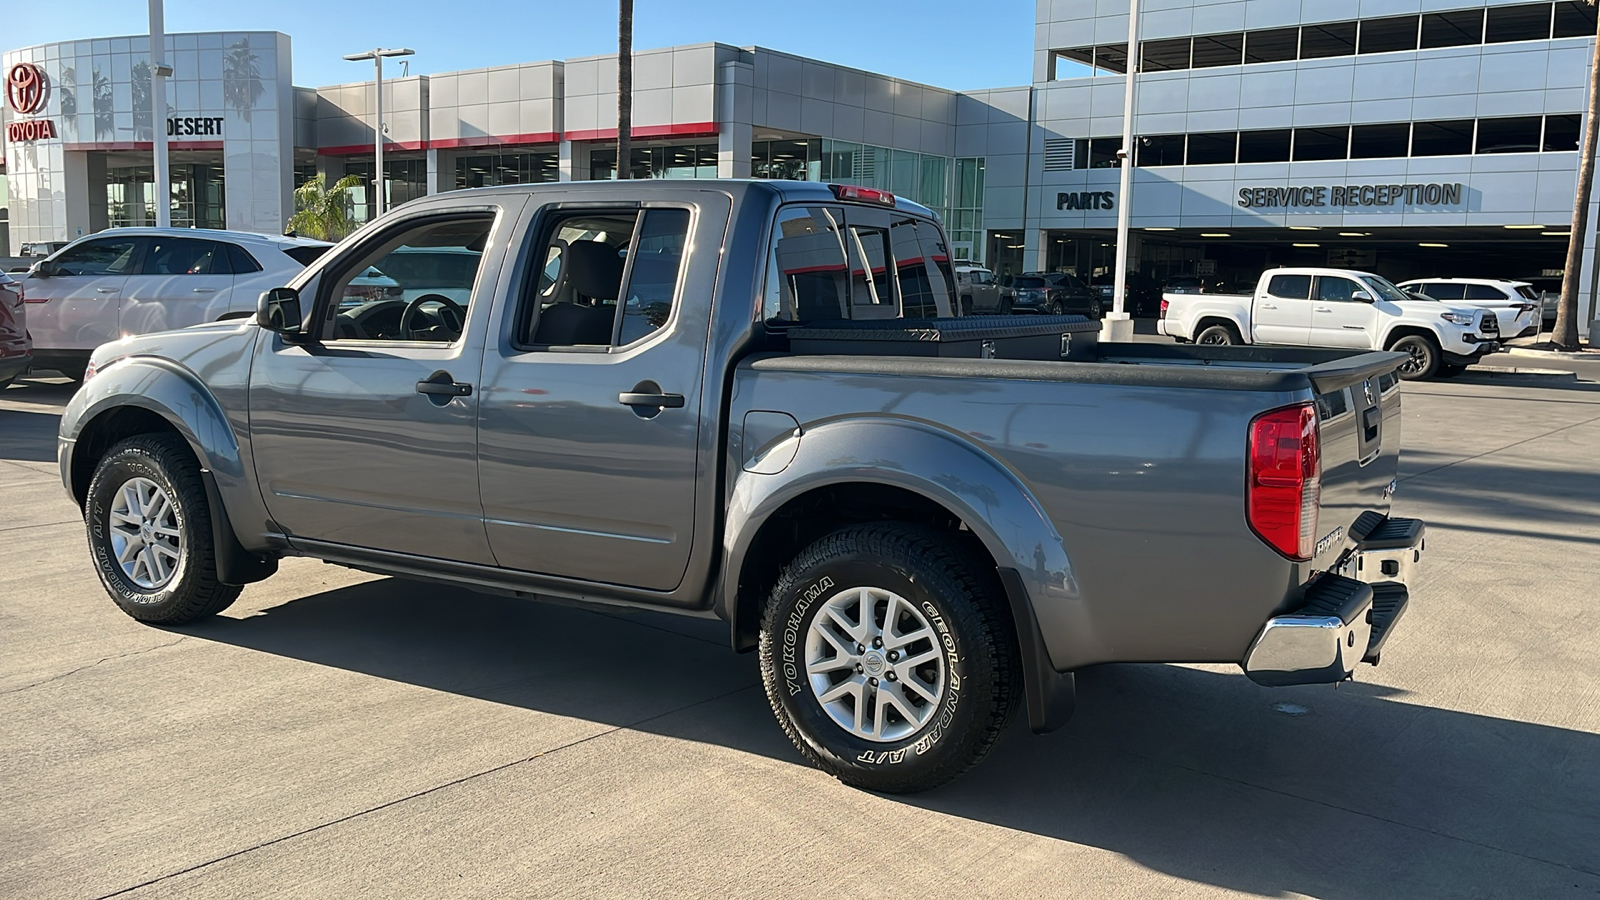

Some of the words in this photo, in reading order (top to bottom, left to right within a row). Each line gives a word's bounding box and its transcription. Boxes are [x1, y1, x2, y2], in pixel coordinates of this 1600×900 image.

[6, 119, 52, 142] TOYOTA
[167, 117, 224, 136] DESERT
[1057, 191, 1114, 210] PARTS
[1238, 186, 1326, 208] SERVICE
[1332, 183, 1462, 206] RECEPTION
[782, 576, 835, 697] YOKOHAMA
[915, 601, 962, 756] GEOLANDAR
[857, 748, 907, 765] A/T
